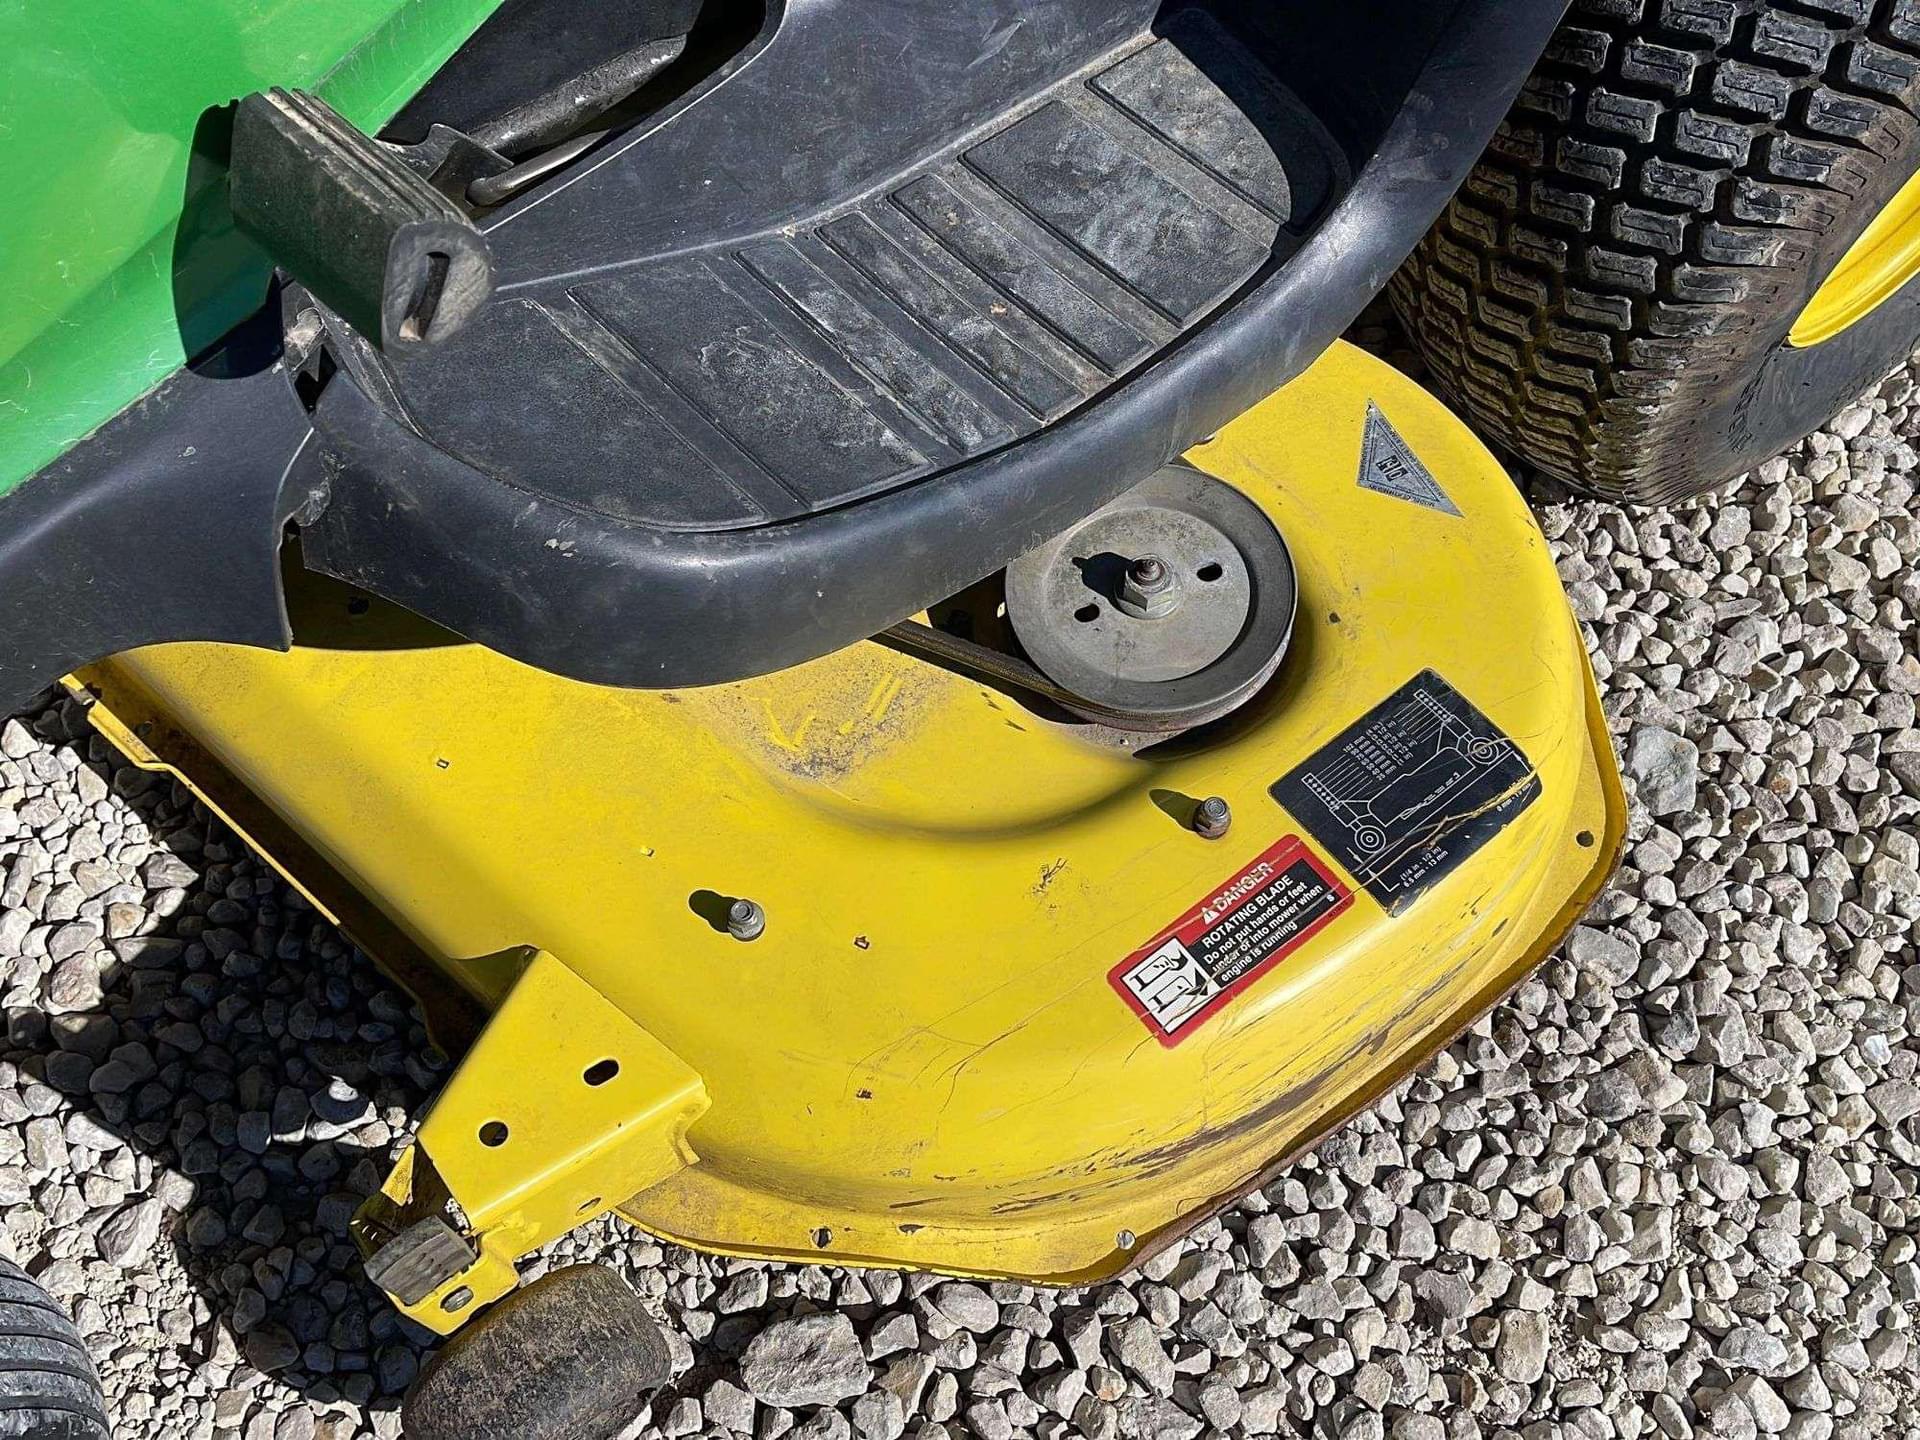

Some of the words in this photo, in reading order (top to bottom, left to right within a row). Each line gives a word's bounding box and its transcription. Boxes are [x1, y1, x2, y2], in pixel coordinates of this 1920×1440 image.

[1358, 739, 1370, 750] mm
[1374, 754, 1386, 765] mm
[1379, 759, 1391, 770] mm
[1212, 859, 1274, 913] DANGER
[1399, 868, 1413, 881] (1/4
[1411, 862, 1419, 871] in
[1421, 852, 1432, 862] 1/2
[1430, 845, 1441, 855] in)
[1402, 876, 1415, 887] 6.5
[1413, 868, 1426, 879] mm
[1427, 858, 1437, 867] 13
[1435, 849, 1448, 861] mm
[1201, 901, 1258, 949] ROTATING
[1254, 873, 1294, 907] BLADE
[1204, 948, 1220, 964] Do
[1217, 936, 1236, 953] not
[1234, 924, 1253, 943] put
[1249, 902, 1279, 929] hands
[1277, 894, 1290, 907] or
[1286, 880, 1308, 899] feet
[1211, 947, 1241, 974] under
[1238, 940, 1251, 952] or
[1249, 924, 1270, 943] into
[1268, 902, 1300, 929] mower
[1296, 882, 1323, 906] when
[1219, 953, 1254, 984] engine
[1250, 945, 1262, 958] is
[1259, 918, 1298, 952] running
